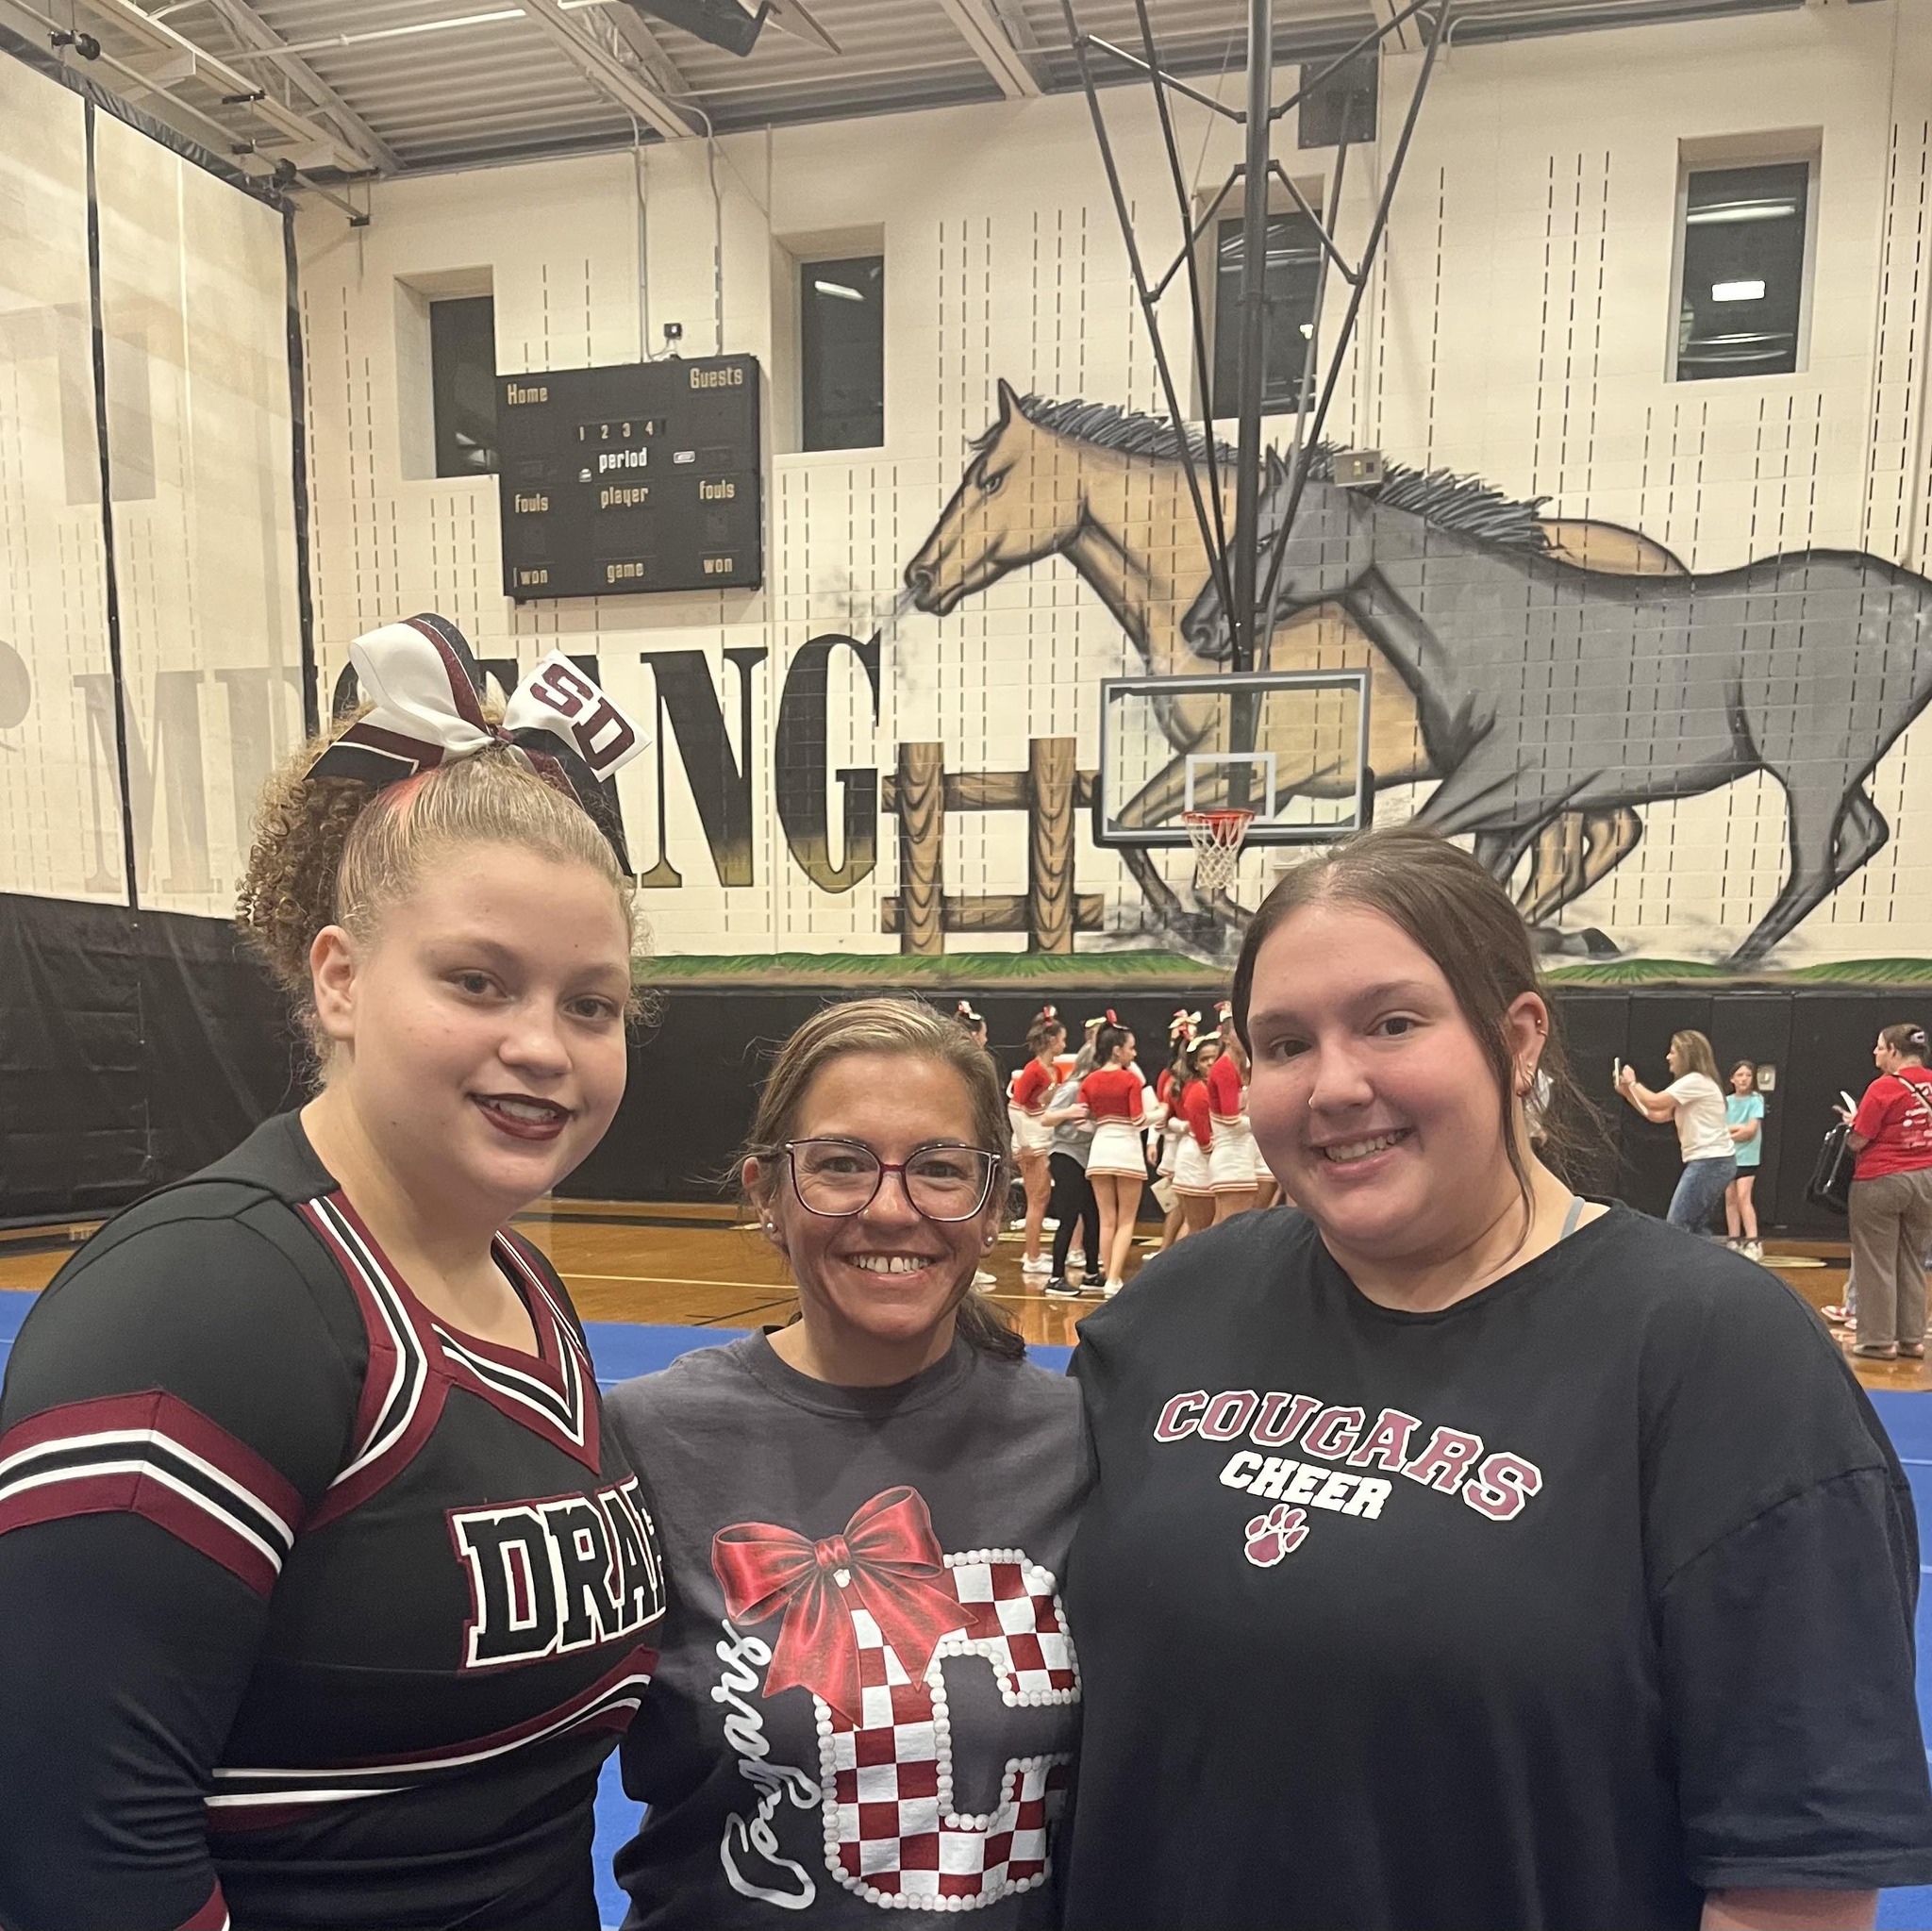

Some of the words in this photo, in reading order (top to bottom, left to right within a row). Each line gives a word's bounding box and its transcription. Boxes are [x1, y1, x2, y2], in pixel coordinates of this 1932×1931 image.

[690, 367, 743, 389] Guests
[507, 383, 548, 405] Home
[579, 426, 585, 441] 1
[601, 424, 609, 440] 2
[622, 423, 631, 438] 3
[645, 421, 654, 436] 4
[598, 447, 647, 473] period
[600, 487, 649, 508] player
[699, 480, 735, 500] fouls
[514, 493, 549, 513] fouls
[520, 569, 548, 585] won
[607, 562, 644, 583] game
[703, 558, 733, 574] won
[530, 663, 635, 771] SD
[1153, 1389, 1543, 1521] COUGARS
[1219, 1450, 1392, 1520] CHEER
[447, 1474, 667, 1673] DRA
[711, 1619, 823, 1910] Cougars
